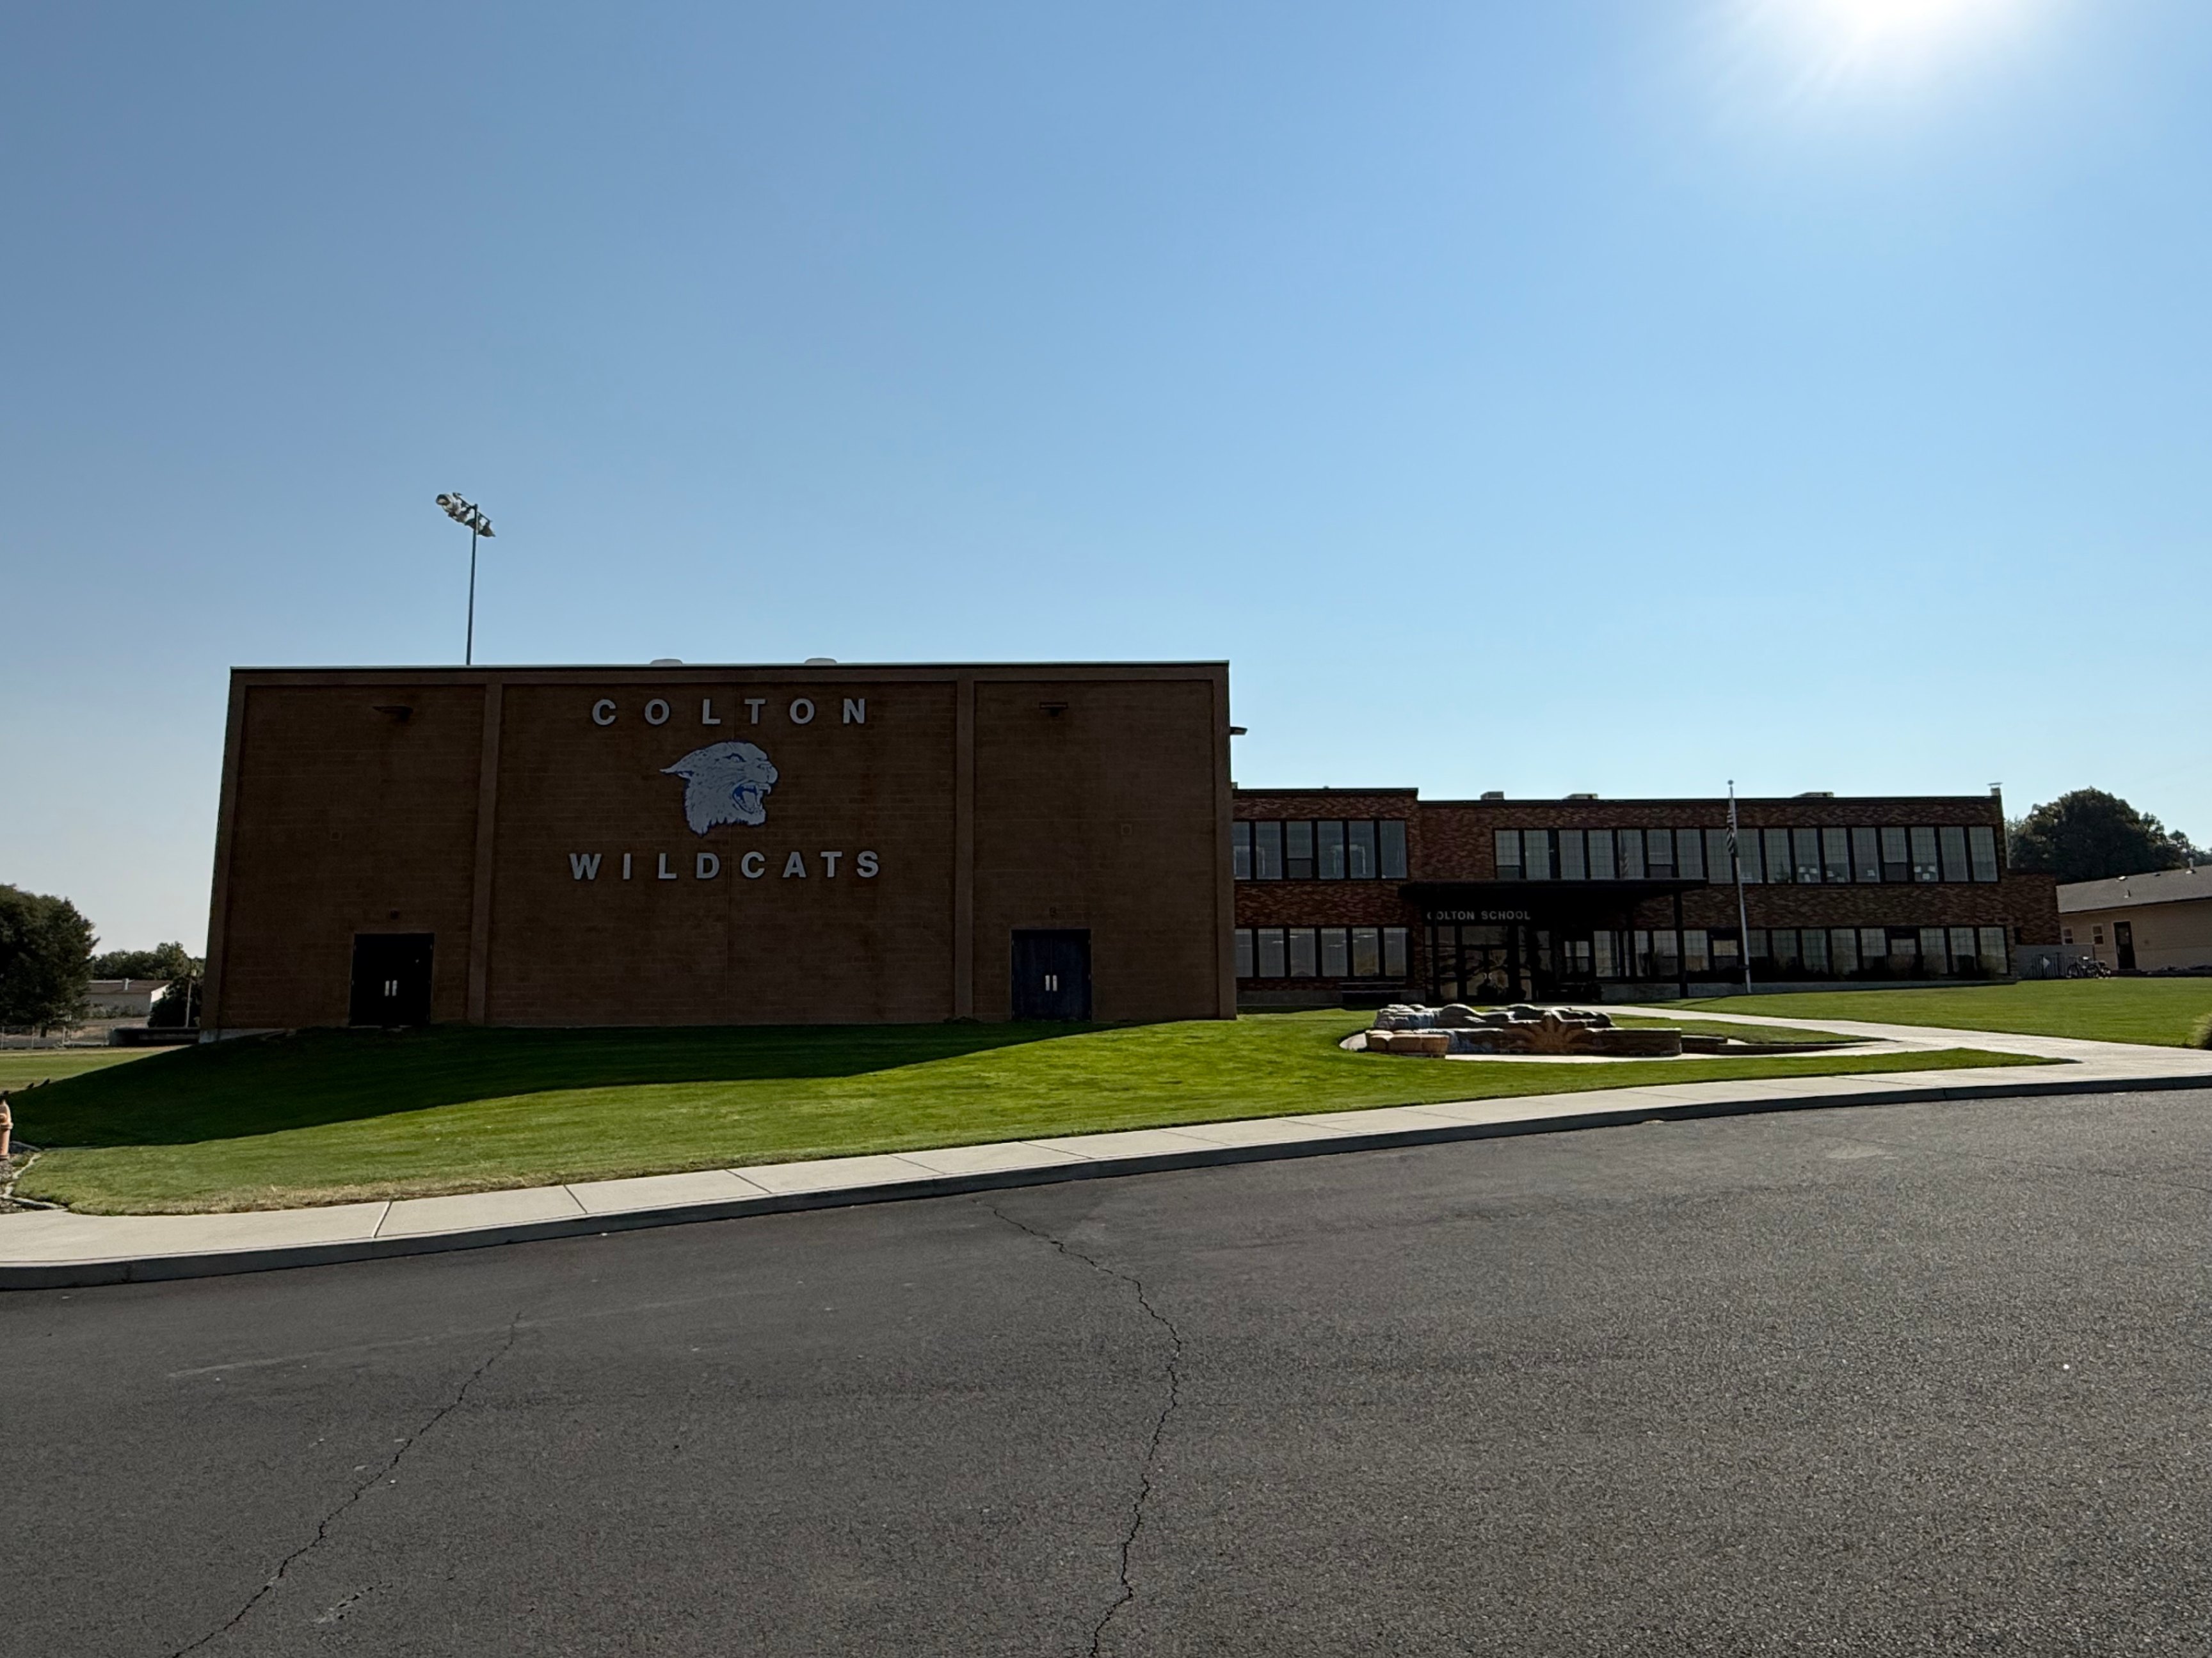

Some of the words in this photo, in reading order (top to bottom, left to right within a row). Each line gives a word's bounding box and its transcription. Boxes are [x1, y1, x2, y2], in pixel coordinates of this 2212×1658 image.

[591, 698, 866, 726] COLTON
[568, 850, 879, 881] WILDCATS
[1480, 910, 1531, 921] SCHOOL
